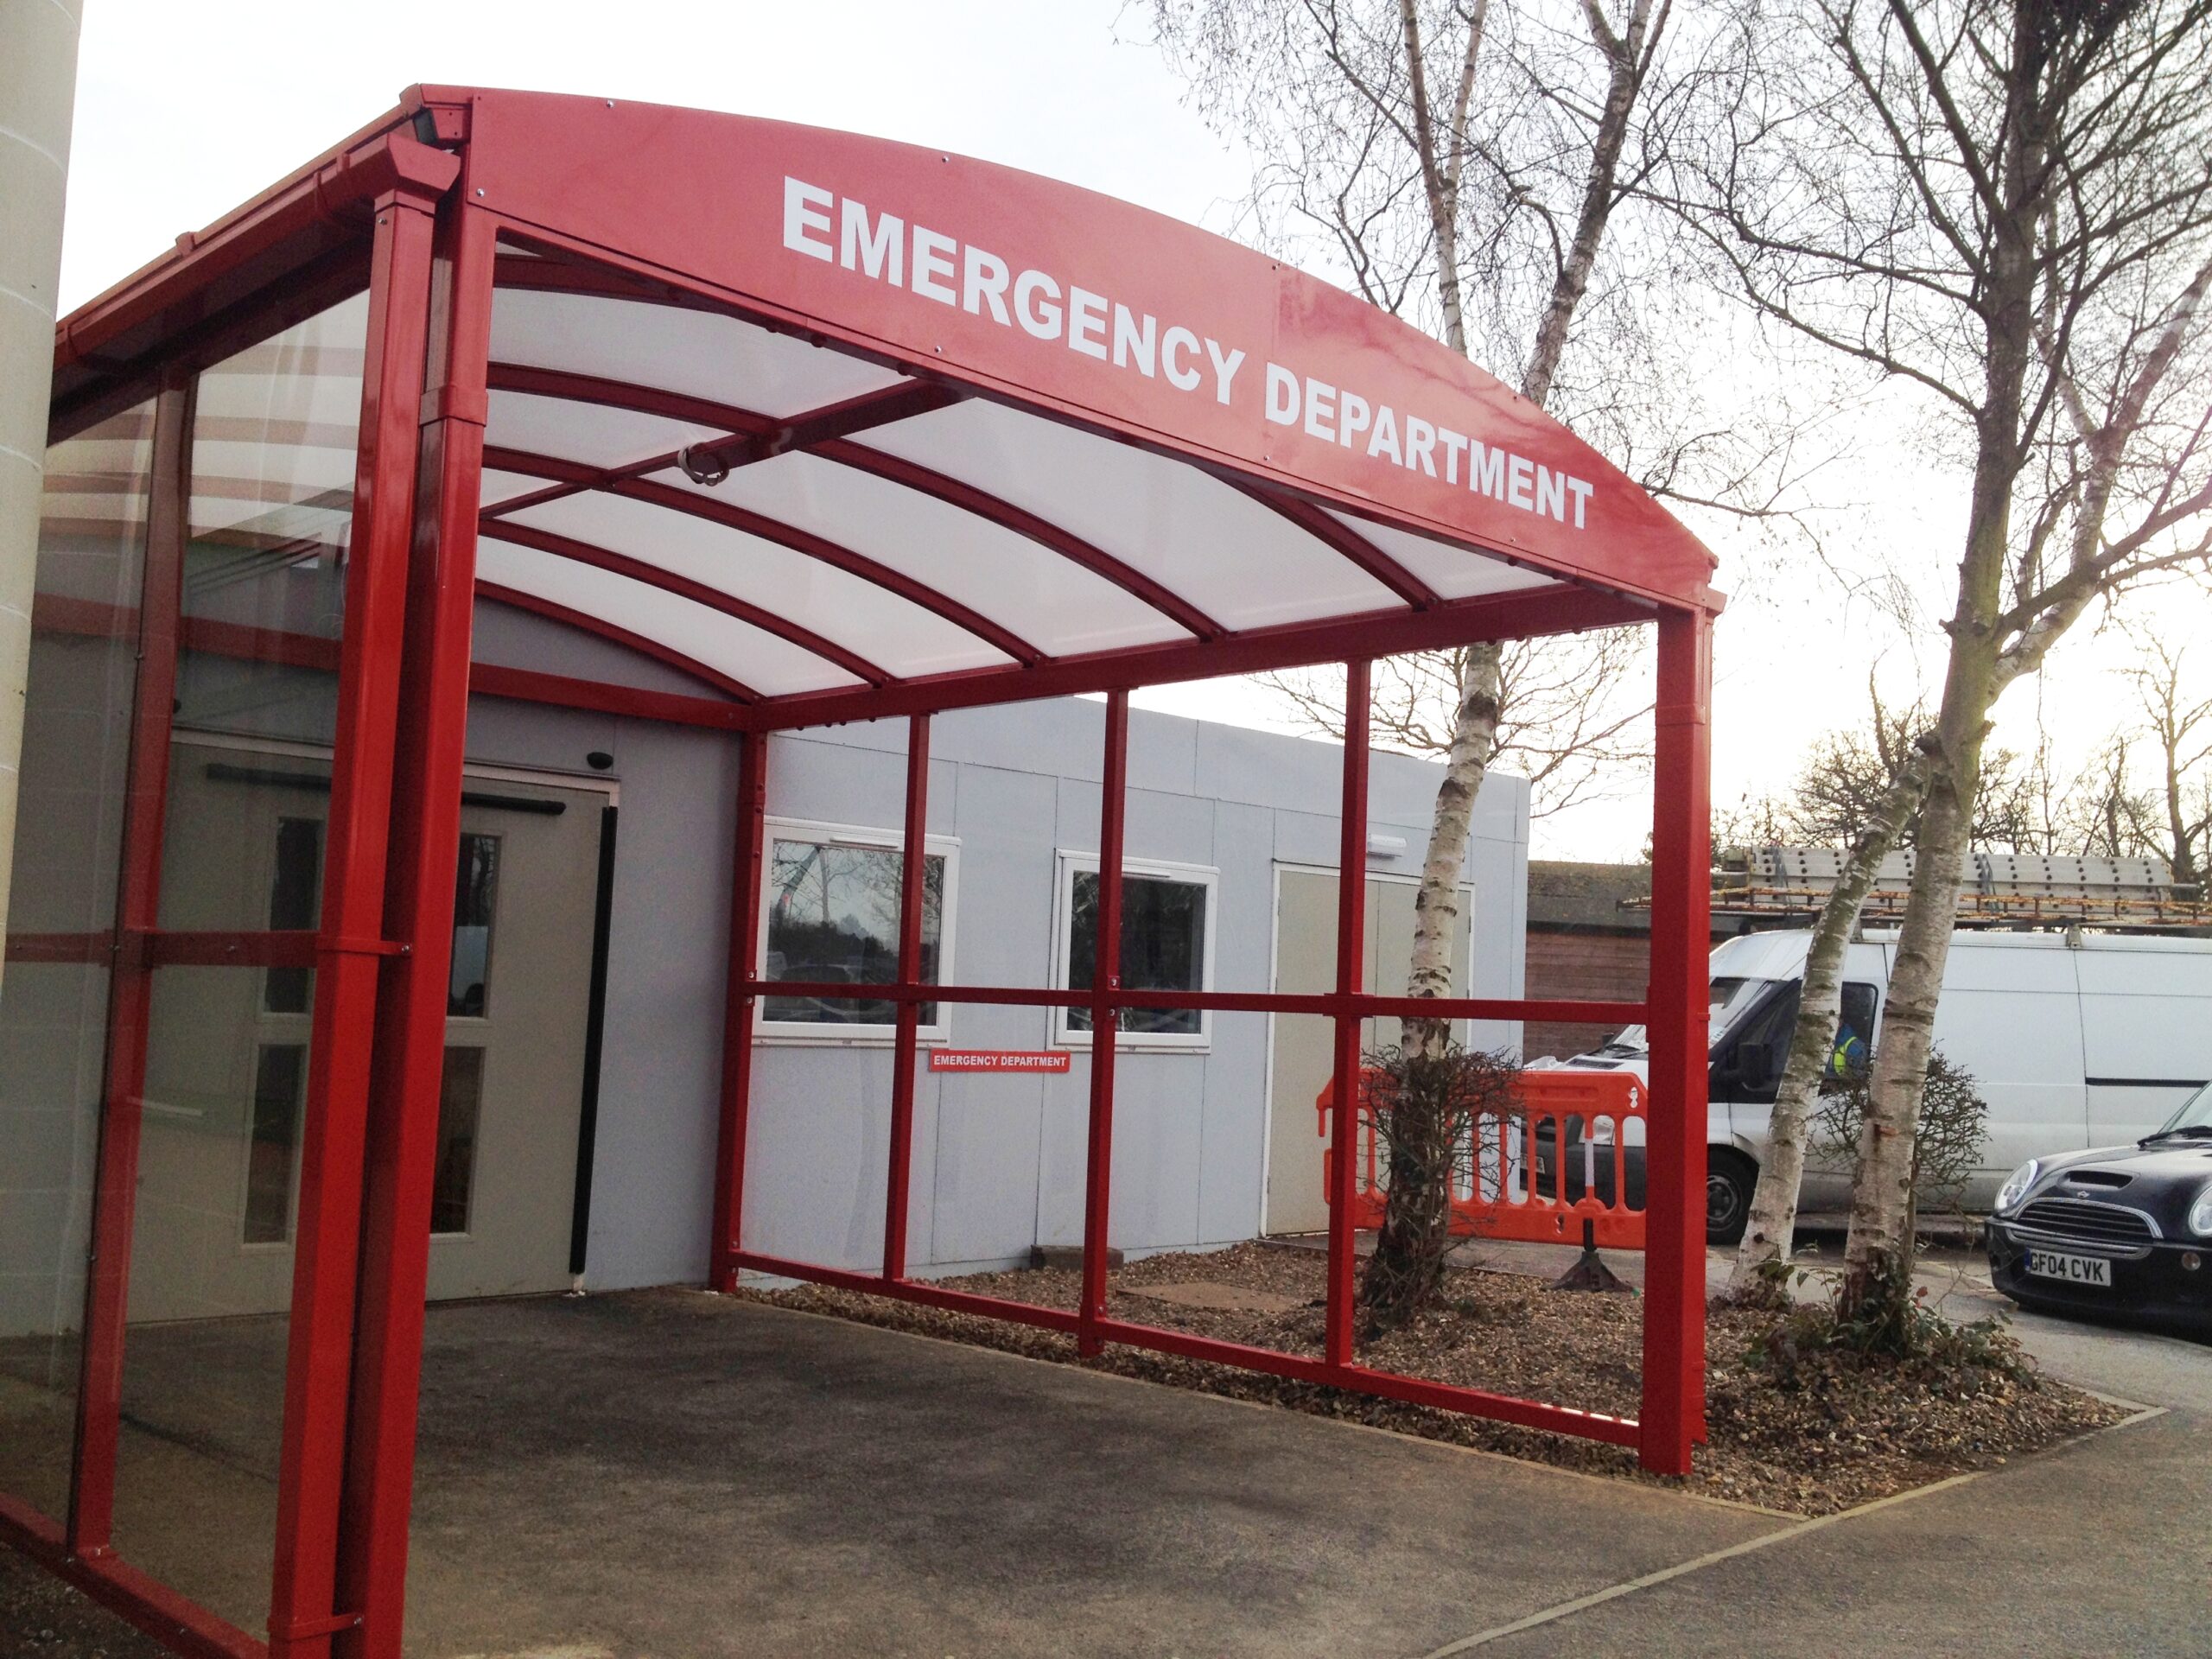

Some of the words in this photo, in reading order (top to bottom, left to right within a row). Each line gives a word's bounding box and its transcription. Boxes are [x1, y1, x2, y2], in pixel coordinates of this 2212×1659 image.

[783, 175, 1246, 406] EMERGENCY
[1264, 361, 1593, 530] DEPARTMENT
[933, 1055, 998, 1066] EMERGENCY
[1001, 1056, 1066, 1067] DEPARTMENT
[2031, 1252, 2067, 1276] GF04
[2071, 1258, 2103, 1282] CVK
